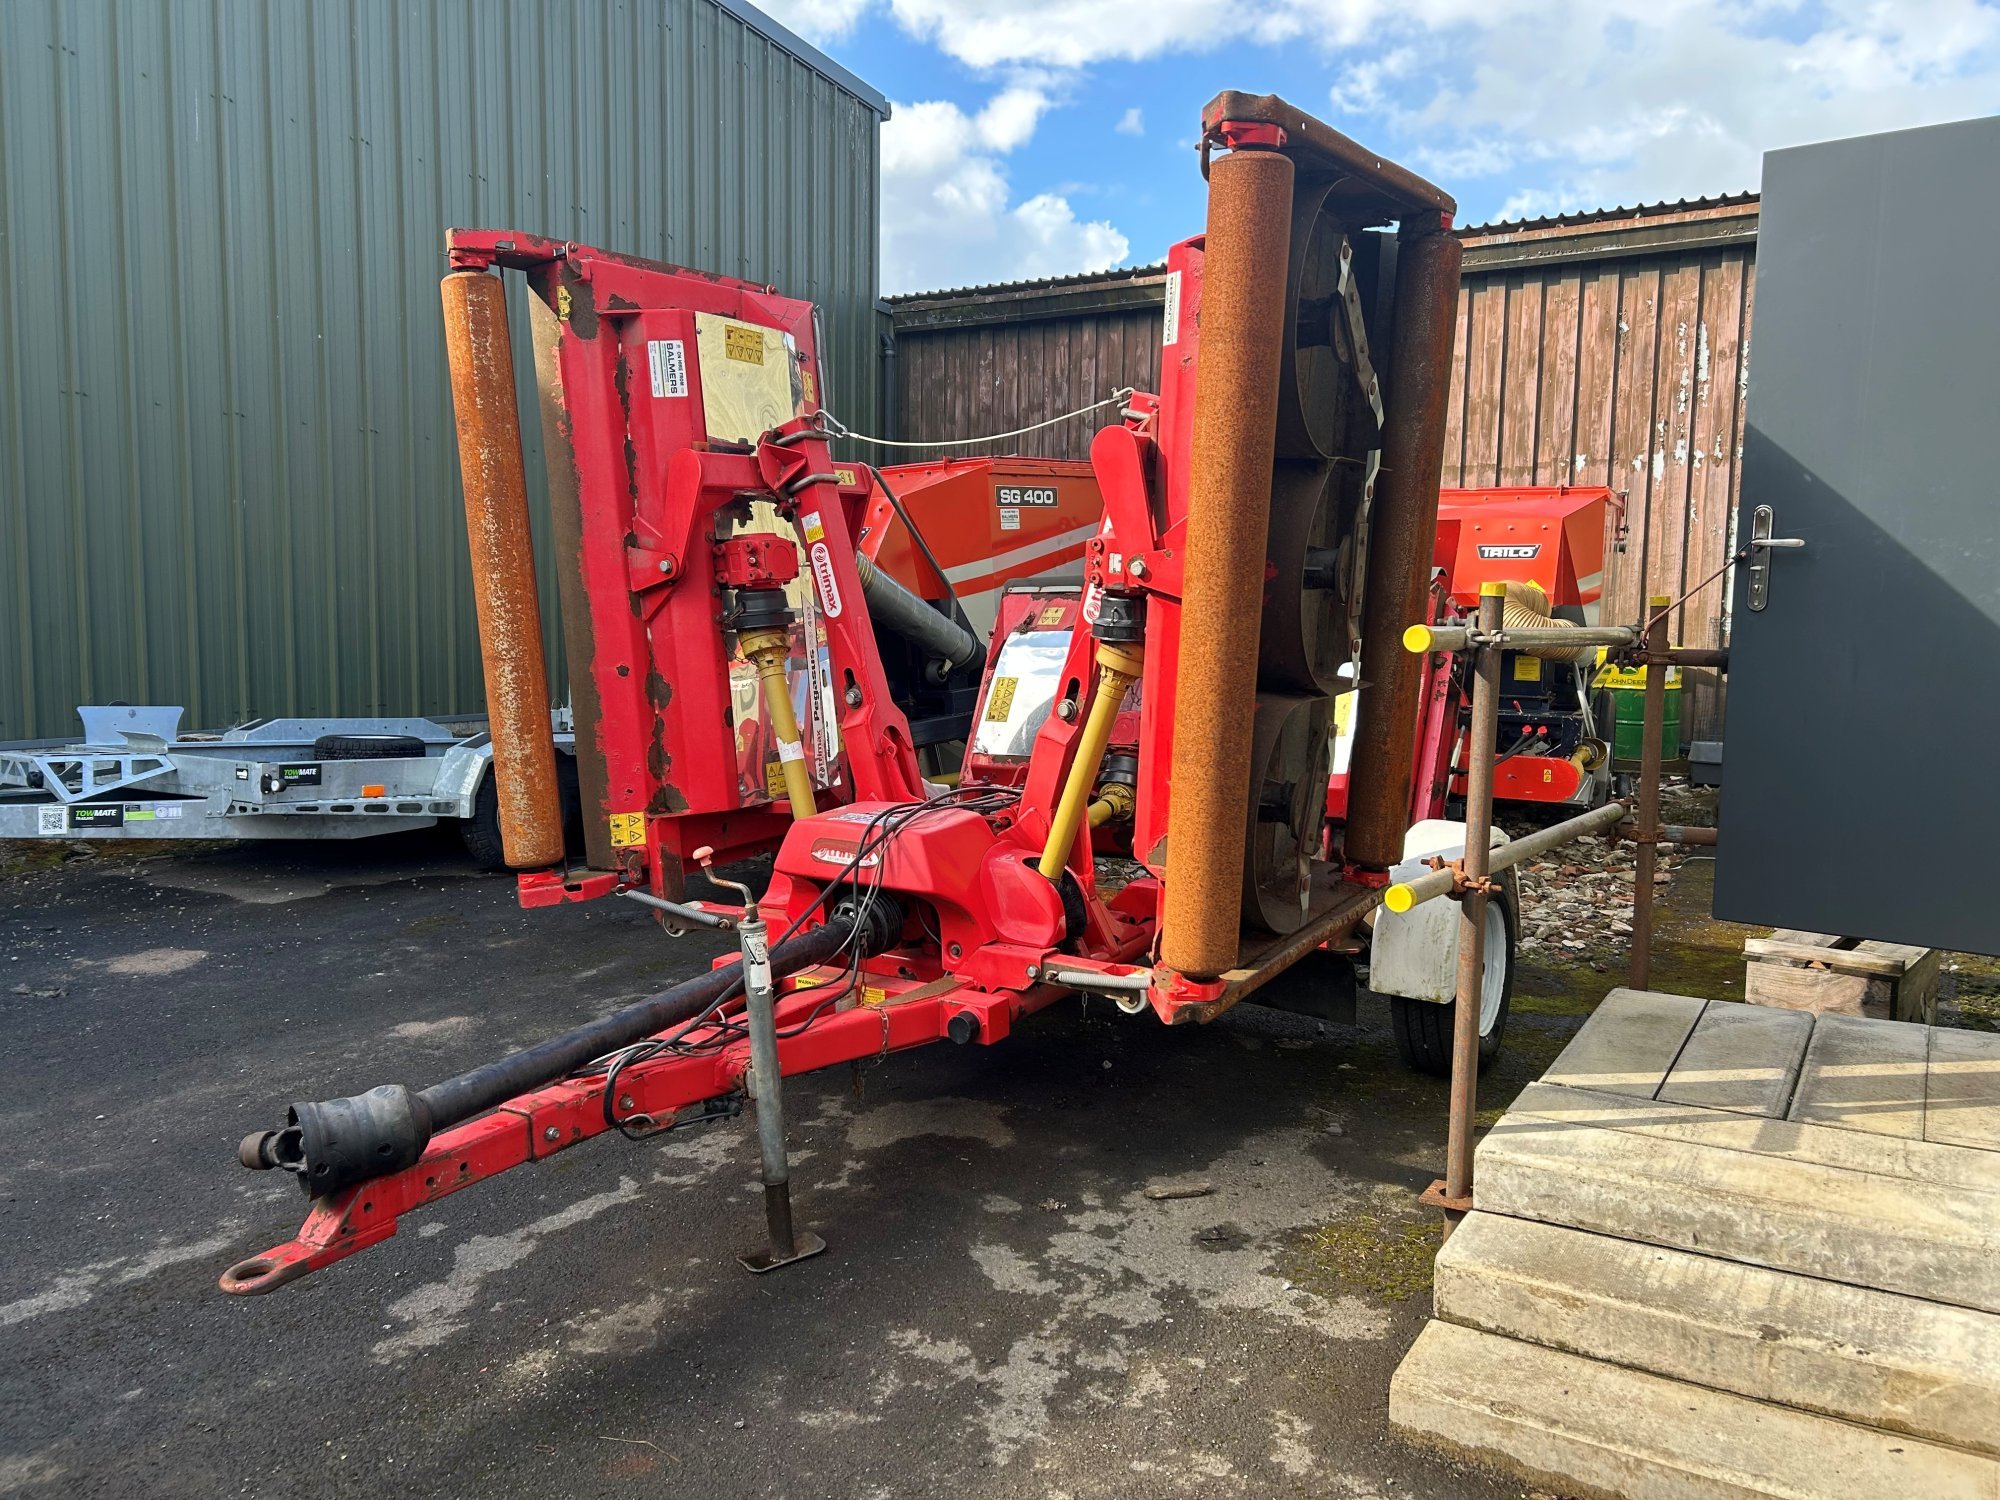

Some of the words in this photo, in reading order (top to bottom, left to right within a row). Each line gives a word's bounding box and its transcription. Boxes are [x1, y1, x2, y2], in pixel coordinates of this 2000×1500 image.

[667, 343, 677, 393] BALMERS
[1000, 490, 1020, 503] SG
[1024, 490, 1054, 504] 400
[1481, 546, 1536, 558] TRILO
[820, 562, 837, 611] trimax
[810, 649, 820, 721] Pegasus
[1627, 678, 1646, 686] DEER
[284, 768, 317, 776] TOWMATE
[75, 809, 117, 817] TOWMATE
